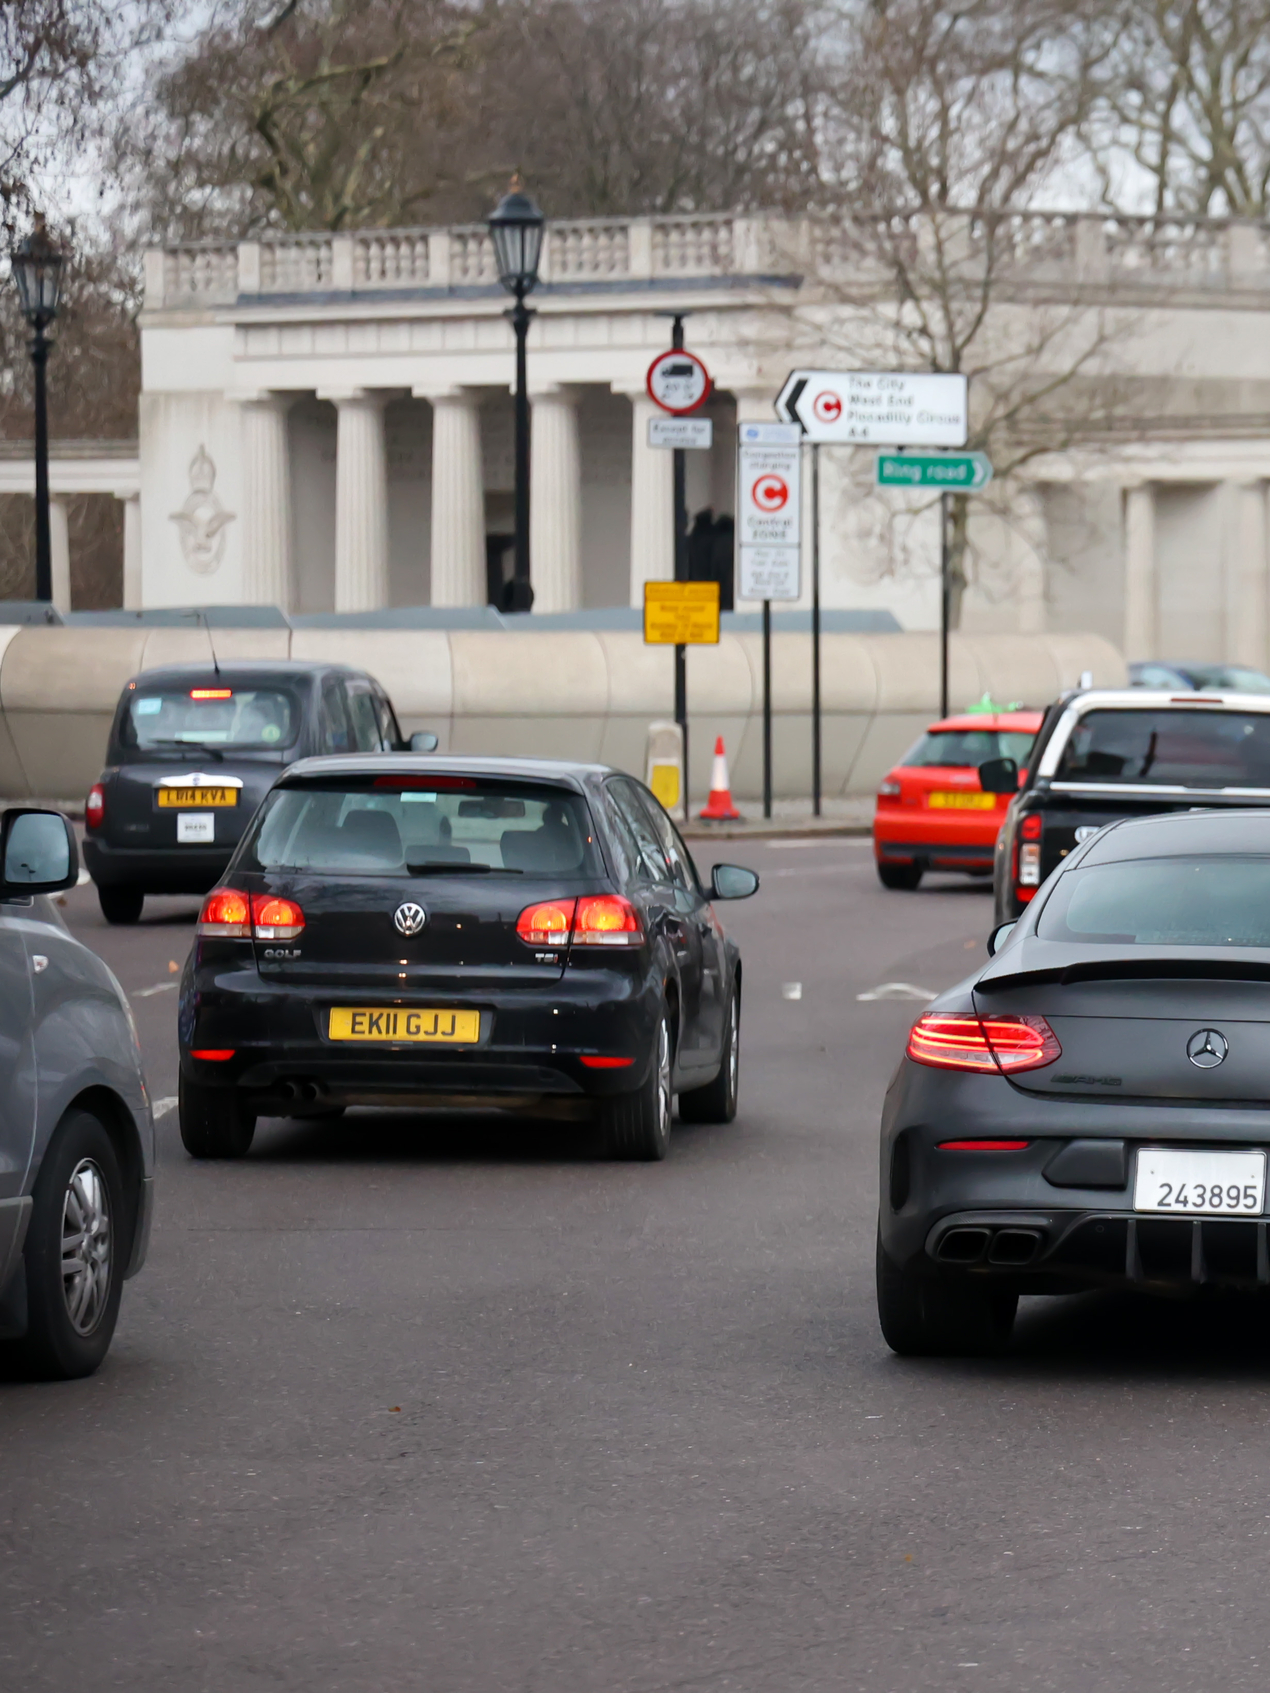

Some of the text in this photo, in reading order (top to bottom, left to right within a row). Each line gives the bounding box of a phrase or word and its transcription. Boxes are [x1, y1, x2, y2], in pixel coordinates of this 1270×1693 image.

[877, 375, 904, 391] City
[848, 394, 914, 407] West End
[847, 410, 960, 426] Piccadilly Circus
[882, 461, 967, 483] Ring road
[264, 949, 302, 959] GOLF
[350, 1012, 456, 1037] EK11 GJJ
[1156, 1182, 1258, 1209] 243895
